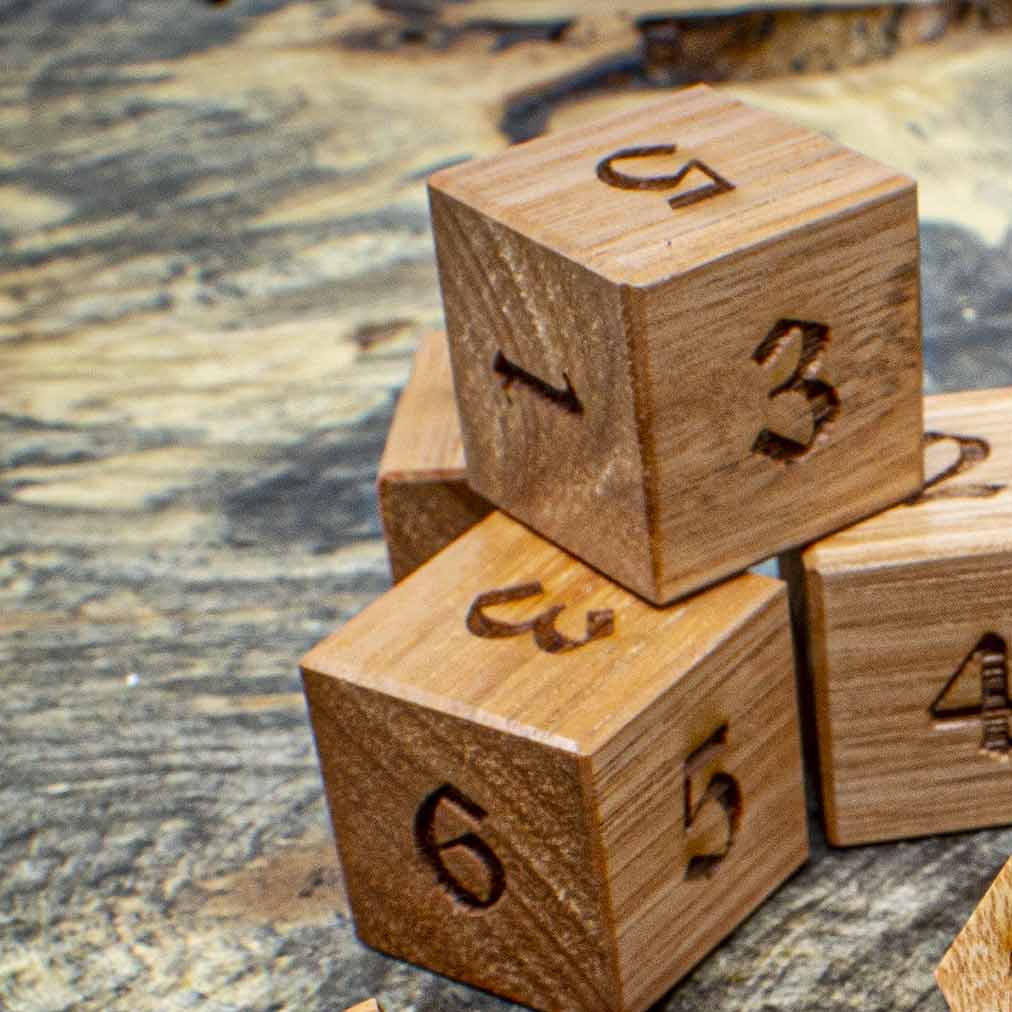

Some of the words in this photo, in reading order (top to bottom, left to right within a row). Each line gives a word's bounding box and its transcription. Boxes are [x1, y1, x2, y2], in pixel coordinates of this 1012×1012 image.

[597, 144, 735, 210] 5
[493, 350, 584, 417] 1
[752, 318, 841, 464] 3
[466, 581, 614, 654] 3
[414, 784, 507, 909] 6
[684, 724, 743, 881] 5
